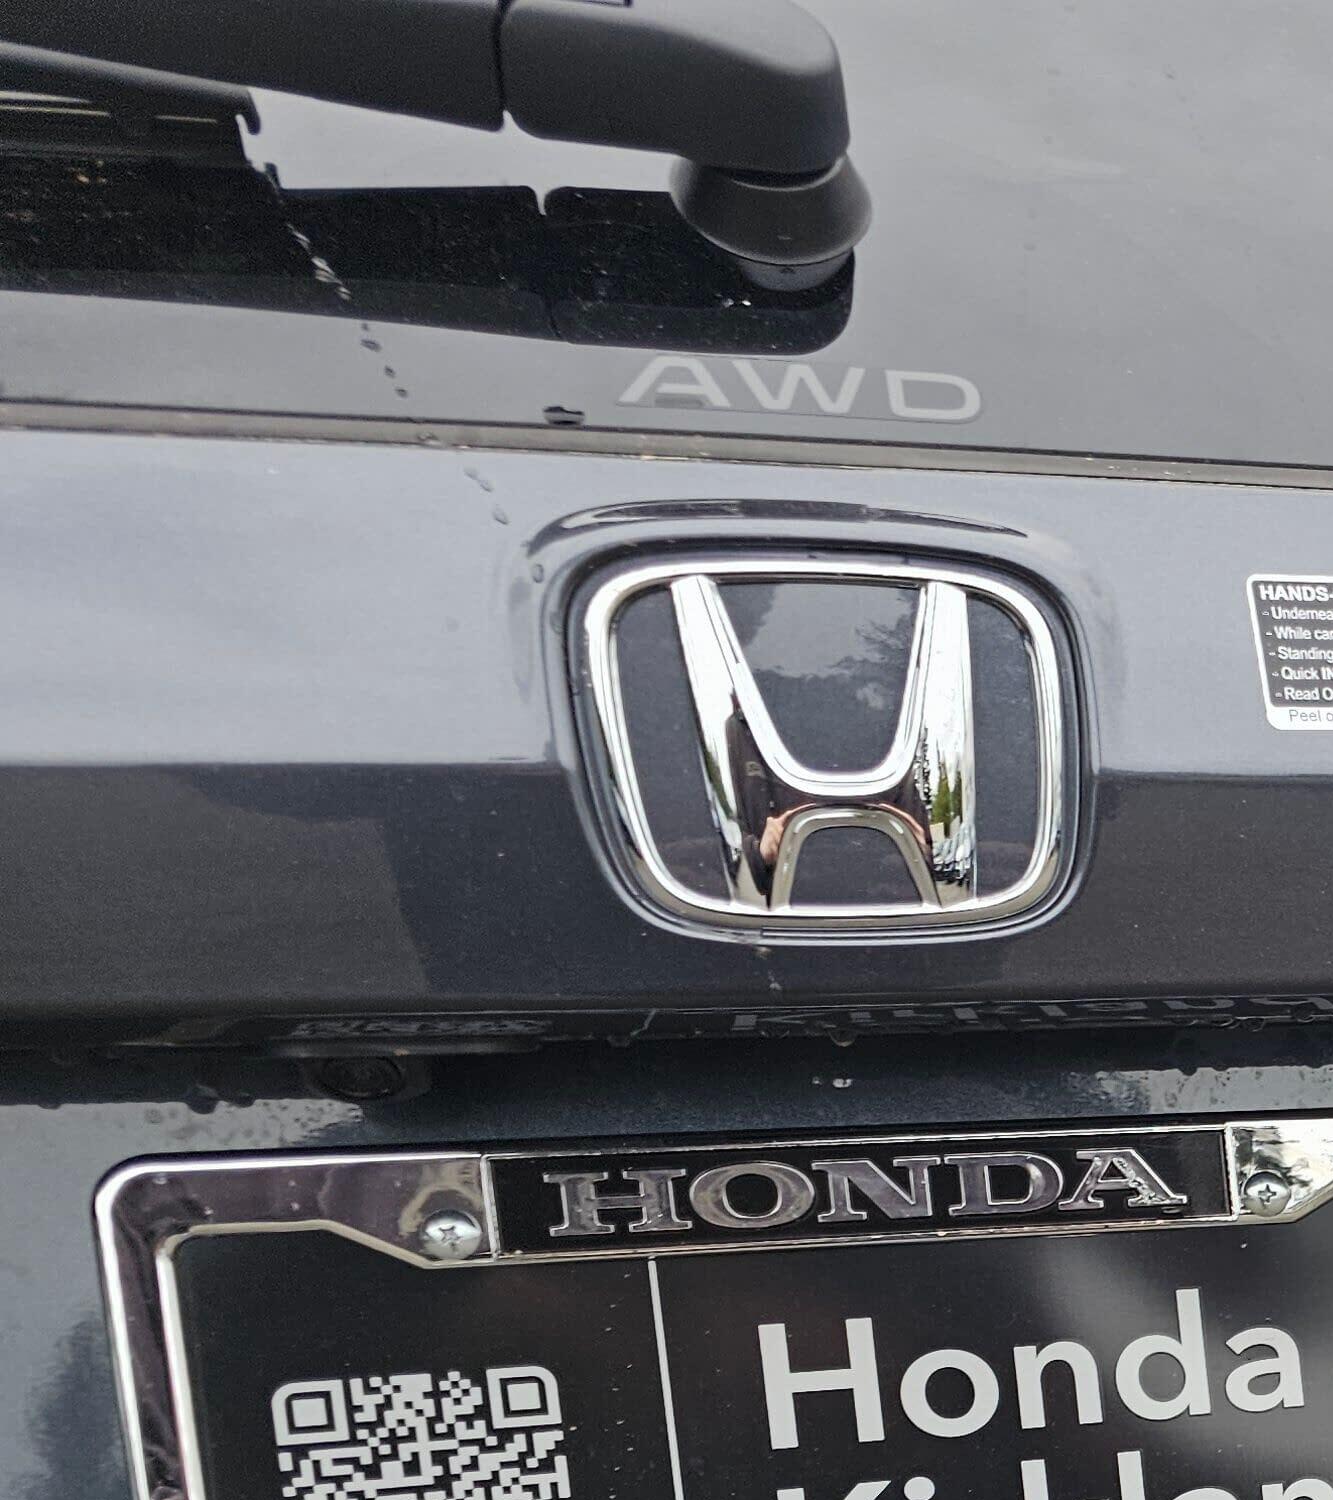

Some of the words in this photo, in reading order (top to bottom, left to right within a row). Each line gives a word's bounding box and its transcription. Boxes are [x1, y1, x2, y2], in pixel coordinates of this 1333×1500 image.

[615, 356, 981, 423] AWD
[1274, 626, 1311, 640] While
[1281, 666, 1320, 680] Quick
[1284, 687, 1319, 700] Read
[1289, 709, 1321, 722] Peel
[542, 1148, 1188, 1238] HONDA
[758, 1288, 1304, 1452] Honda
